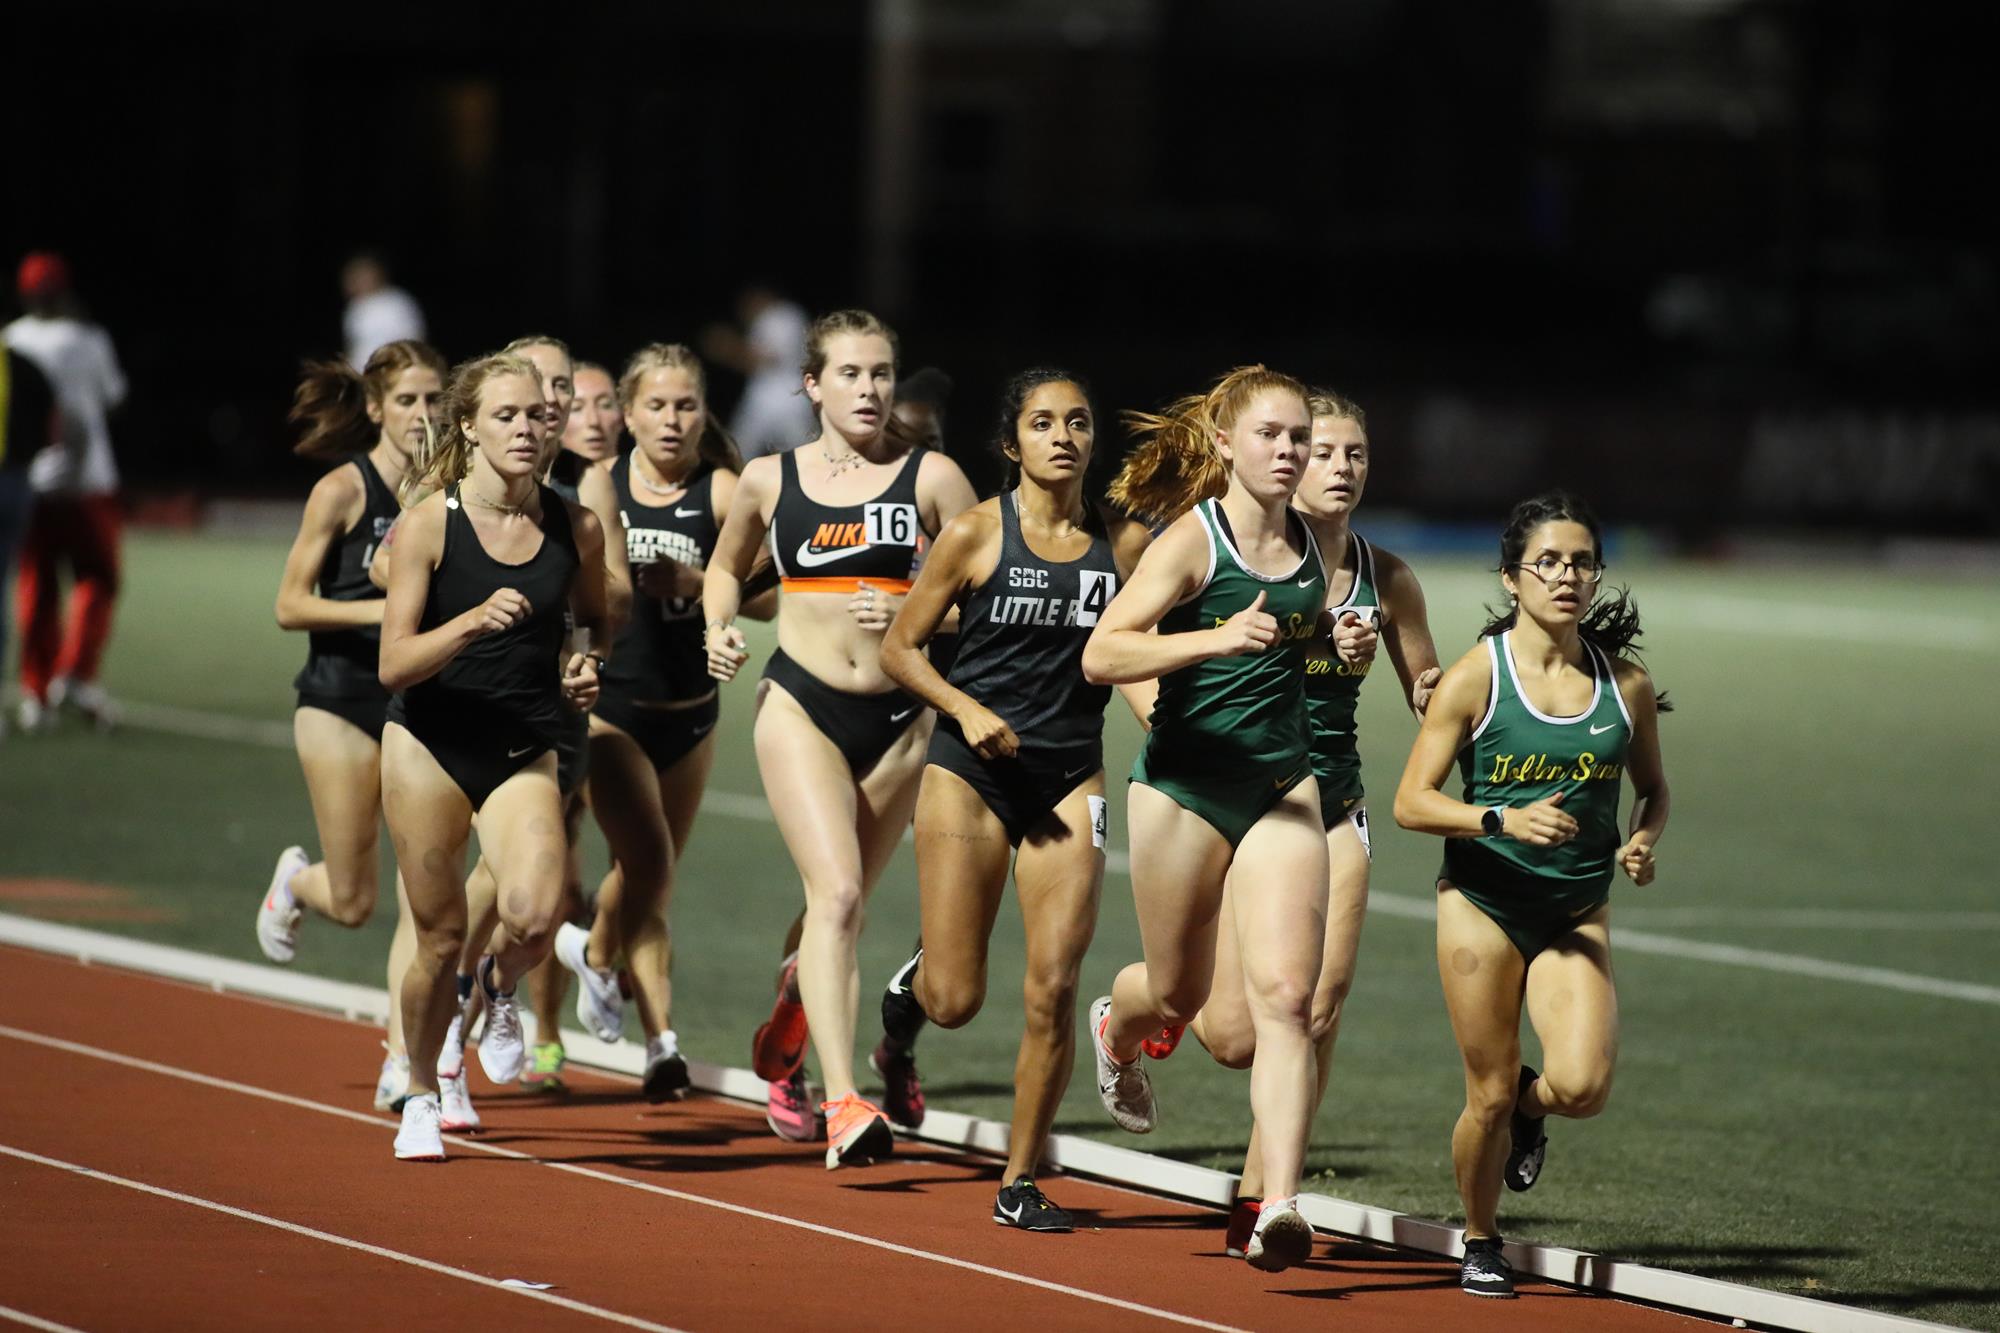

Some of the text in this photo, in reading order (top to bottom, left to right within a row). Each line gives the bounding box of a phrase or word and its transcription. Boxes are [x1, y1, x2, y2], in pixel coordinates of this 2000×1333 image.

[870, 506, 908, 542] 16
[626, 527, 701, 556] NTRAL
[1008, 567, 1049, 589] SBC
[989, 596, 1062, 626] LITTLE
[1083, 575, 1107, 622] 4
